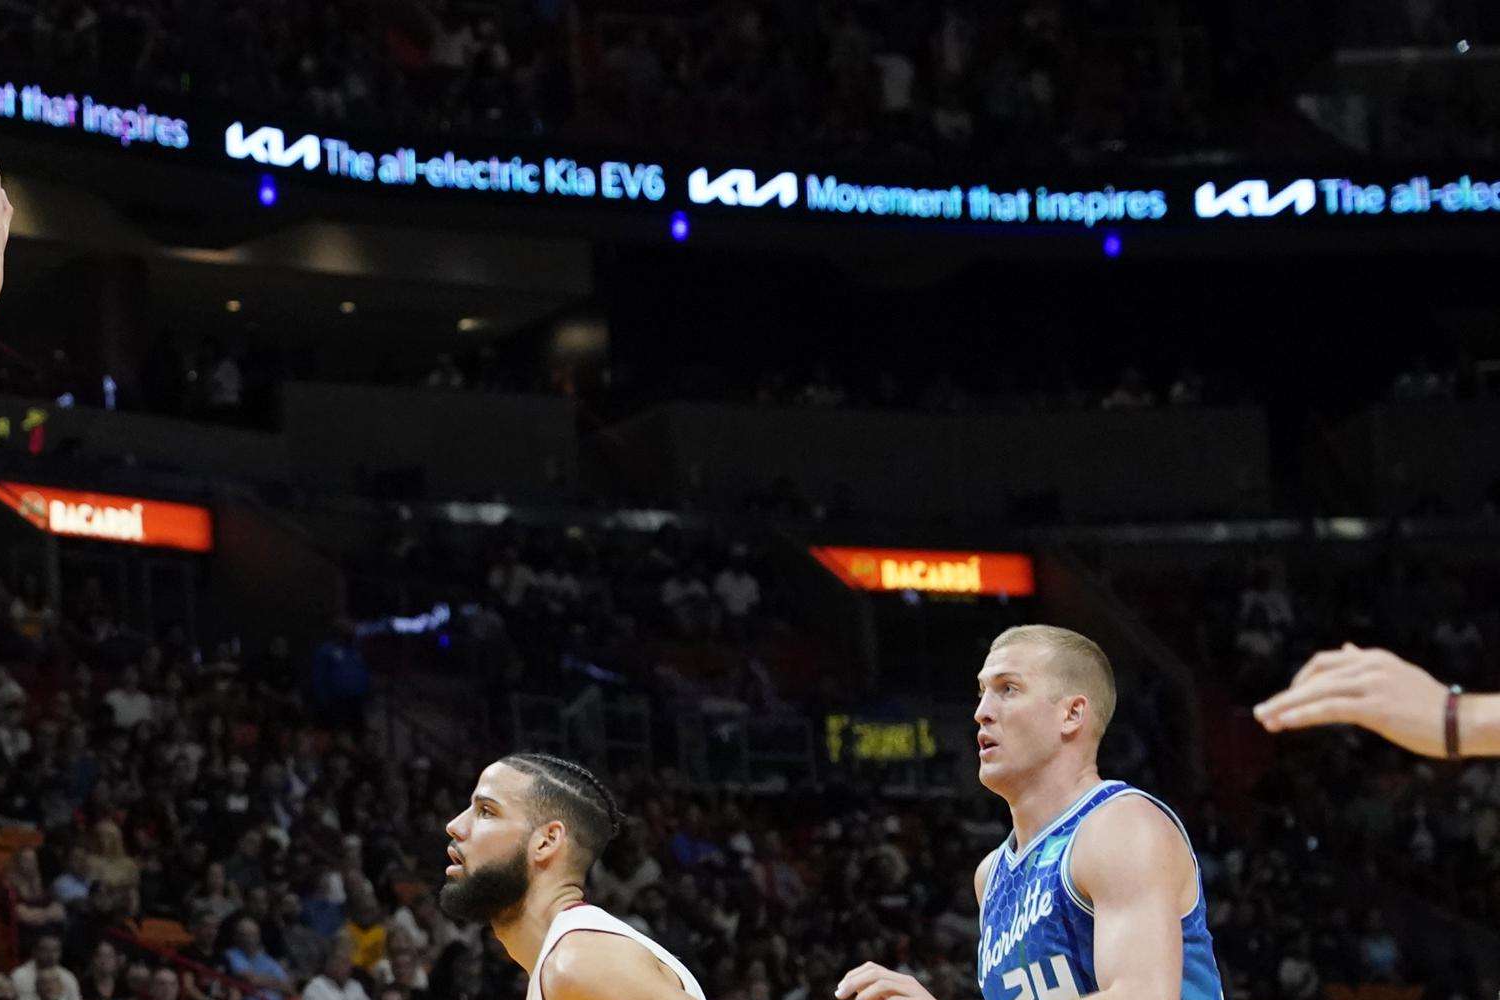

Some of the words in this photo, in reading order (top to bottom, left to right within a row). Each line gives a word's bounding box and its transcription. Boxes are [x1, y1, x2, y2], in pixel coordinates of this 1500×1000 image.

[22, 84, 77, 128] that
[82, 95, 189, 149] inspires
[322, 137, 375, 181] The
[377, 147, 540, 194] all-electric
[544, 157, 596, 197] Kia
[601, 161, 665, 201] EV6
[1318, 177, 1385, 214] The
[806, 174, 962, 219] Movement
[968, 184, 1029, 223] that
[1035, 184, 1167, 228] inspires
